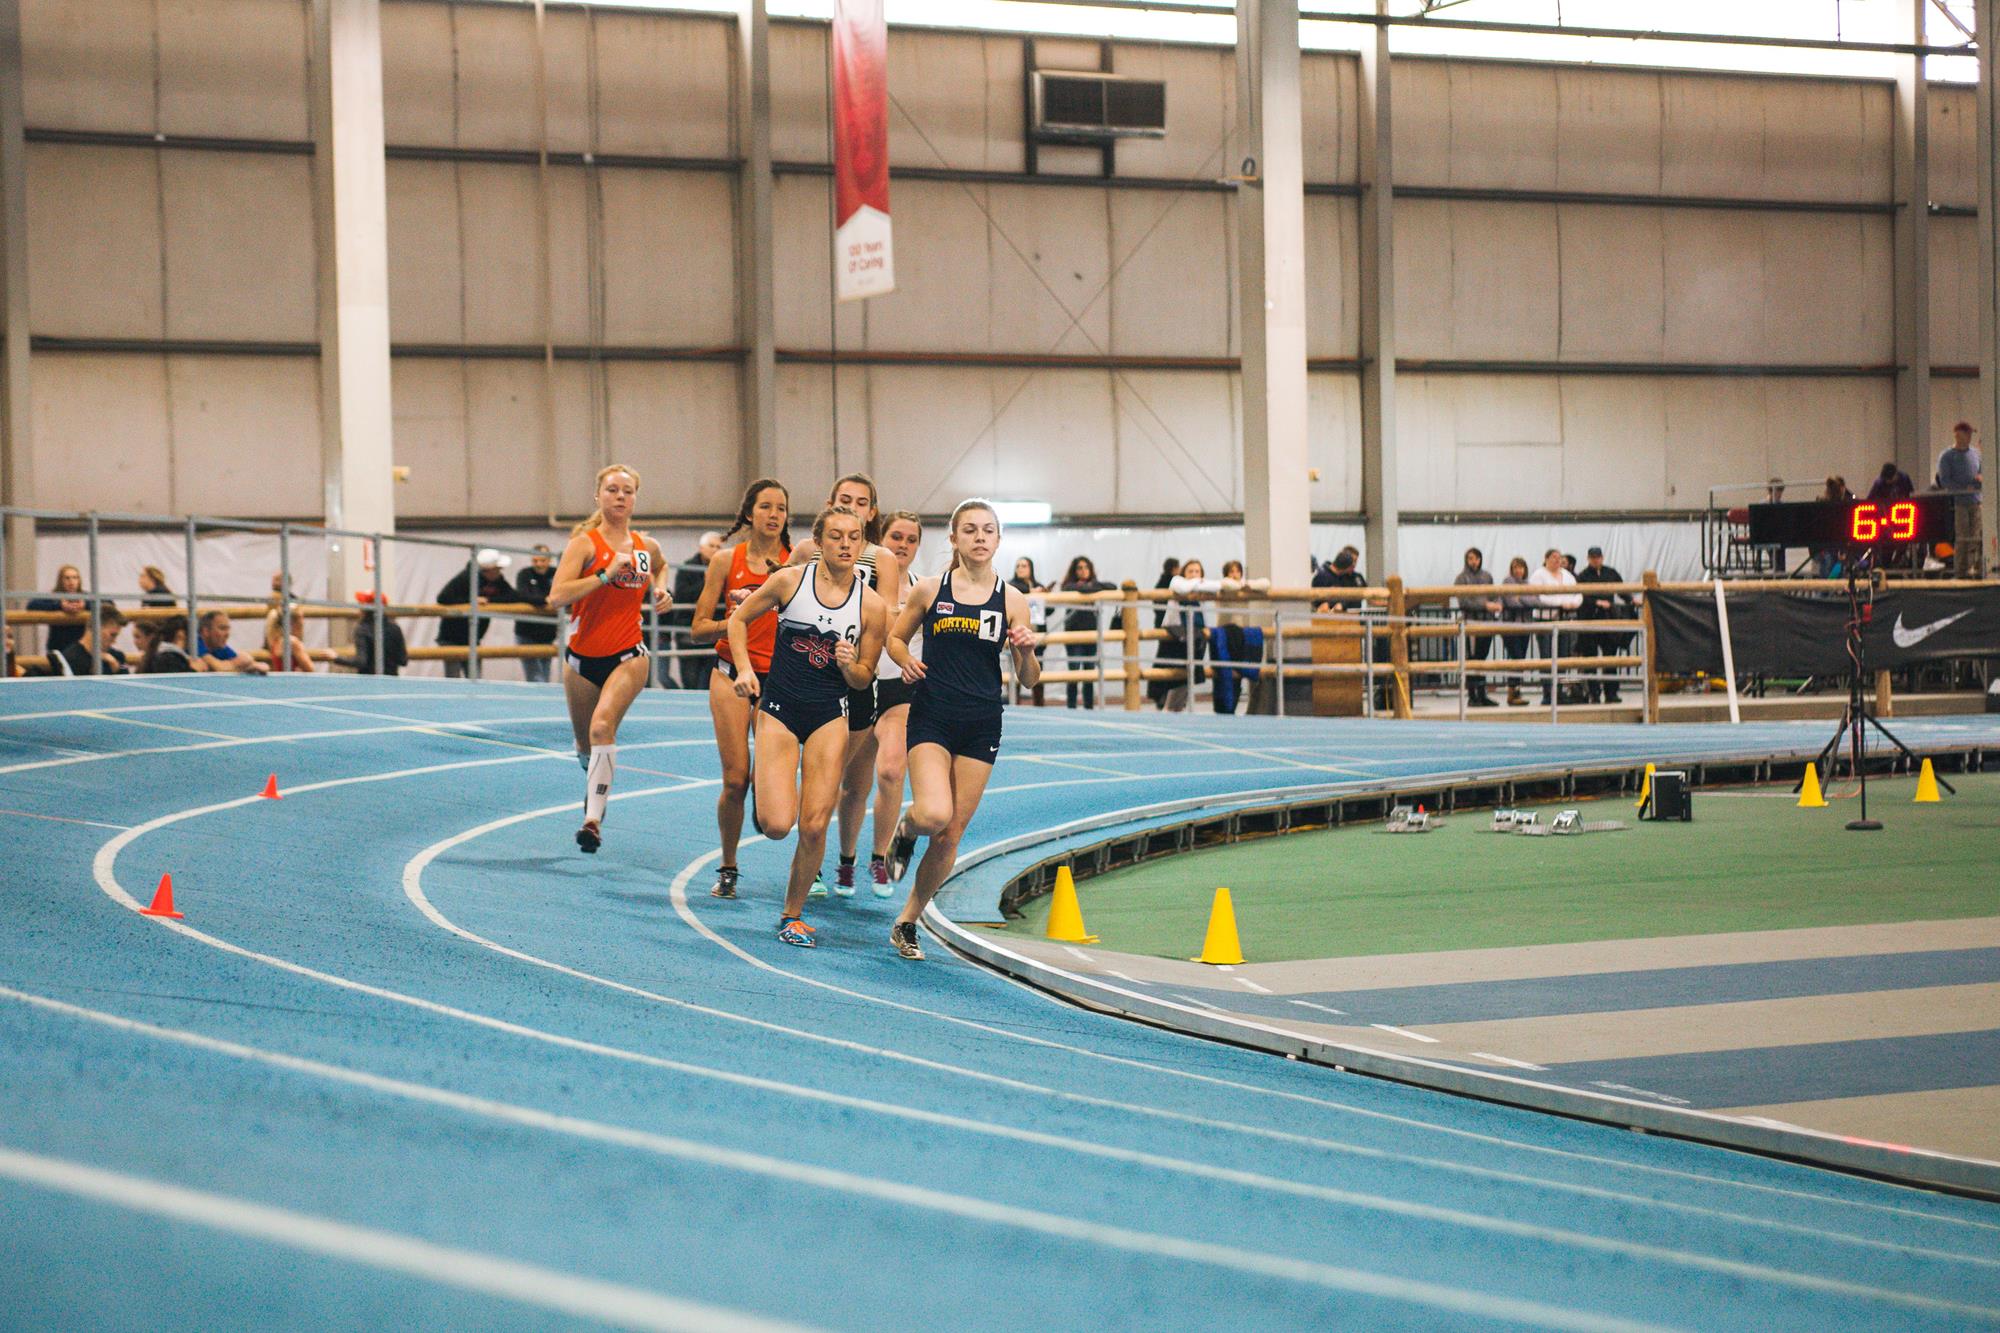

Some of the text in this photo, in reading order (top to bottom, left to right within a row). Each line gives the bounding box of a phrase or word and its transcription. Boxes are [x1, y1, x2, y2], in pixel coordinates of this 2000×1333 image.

[638, 552, 649, 572] 8
[933, 616, 980, 636] NORTHW
[984, 615, 997, 637] 1
